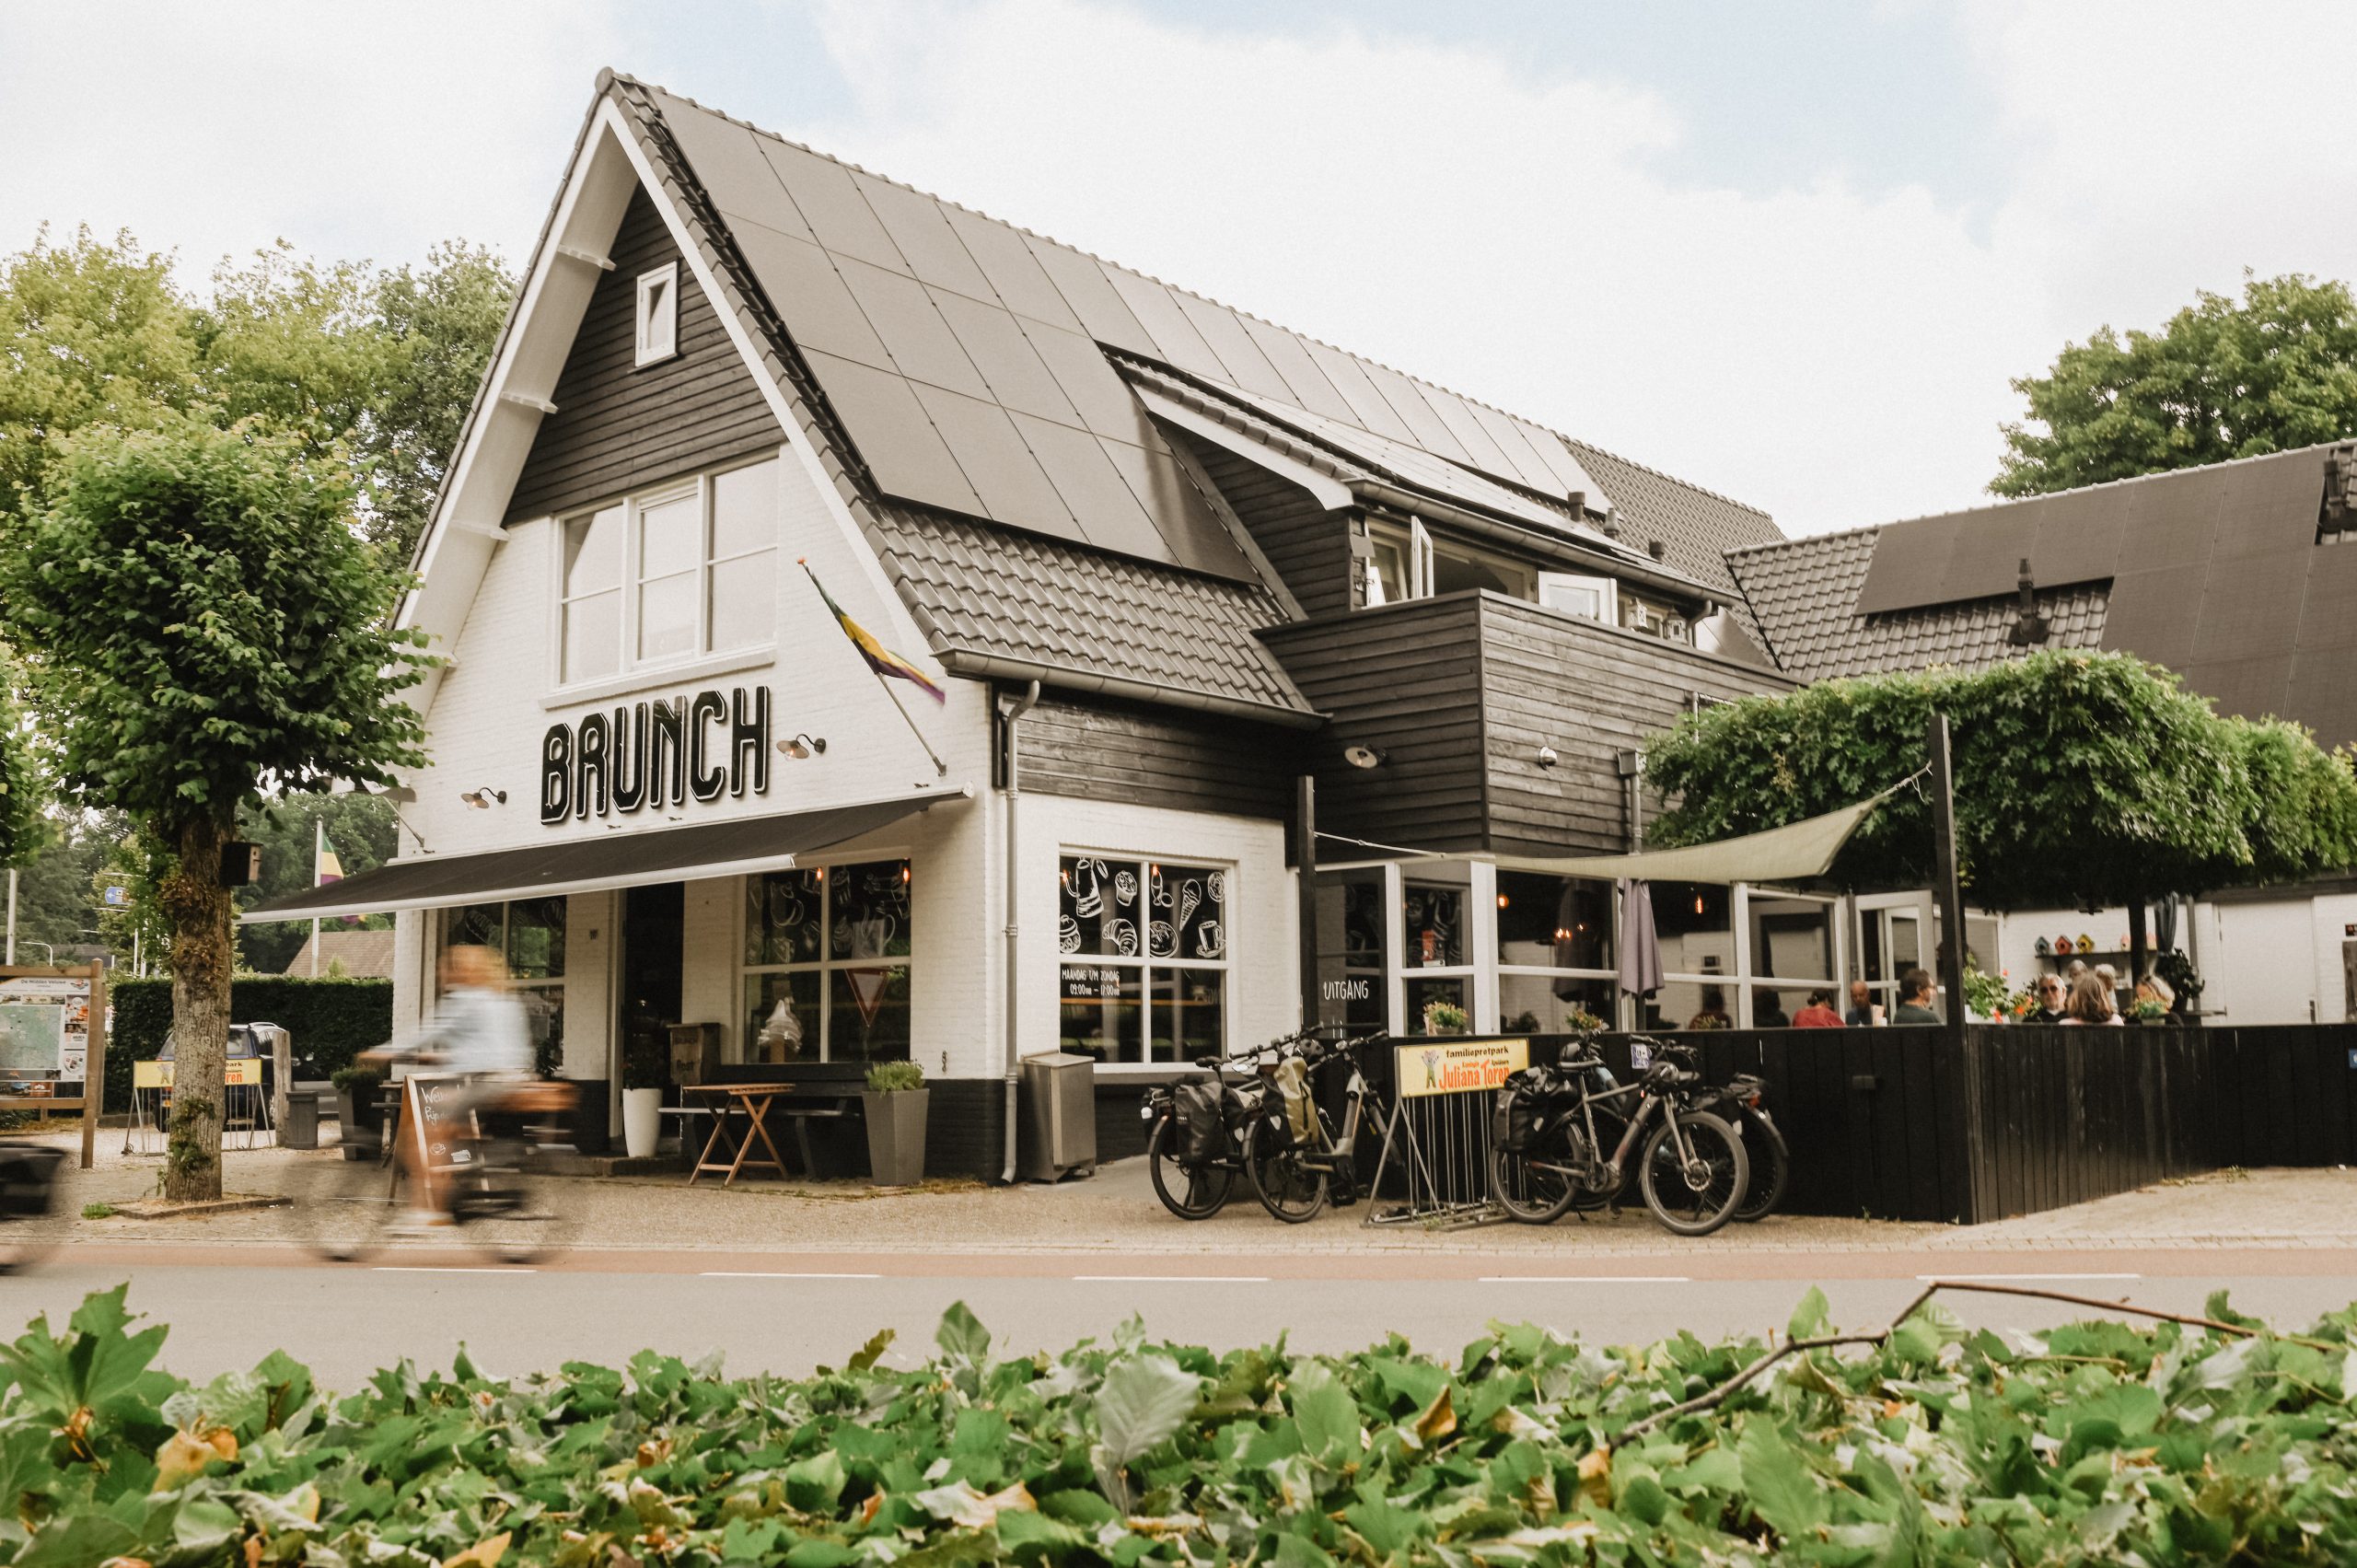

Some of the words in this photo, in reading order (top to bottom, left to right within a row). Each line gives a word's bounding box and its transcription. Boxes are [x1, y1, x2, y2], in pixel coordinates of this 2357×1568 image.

[541, 686, 769, 826] BRUNCH
[1062, 968, 1086, 981] MAANDAG
[1100, 970, 1120, 982] ZONDAG
[1323, 979, 1369, 1001] UITGANG
[1446, 1046, 1509, 1058] familiepretpark
[226, 1073, 242, 1084] ren
[1439, 1063, 1480, 1090] Juliana
[1480, 1059, 1510, 1086] Toren
